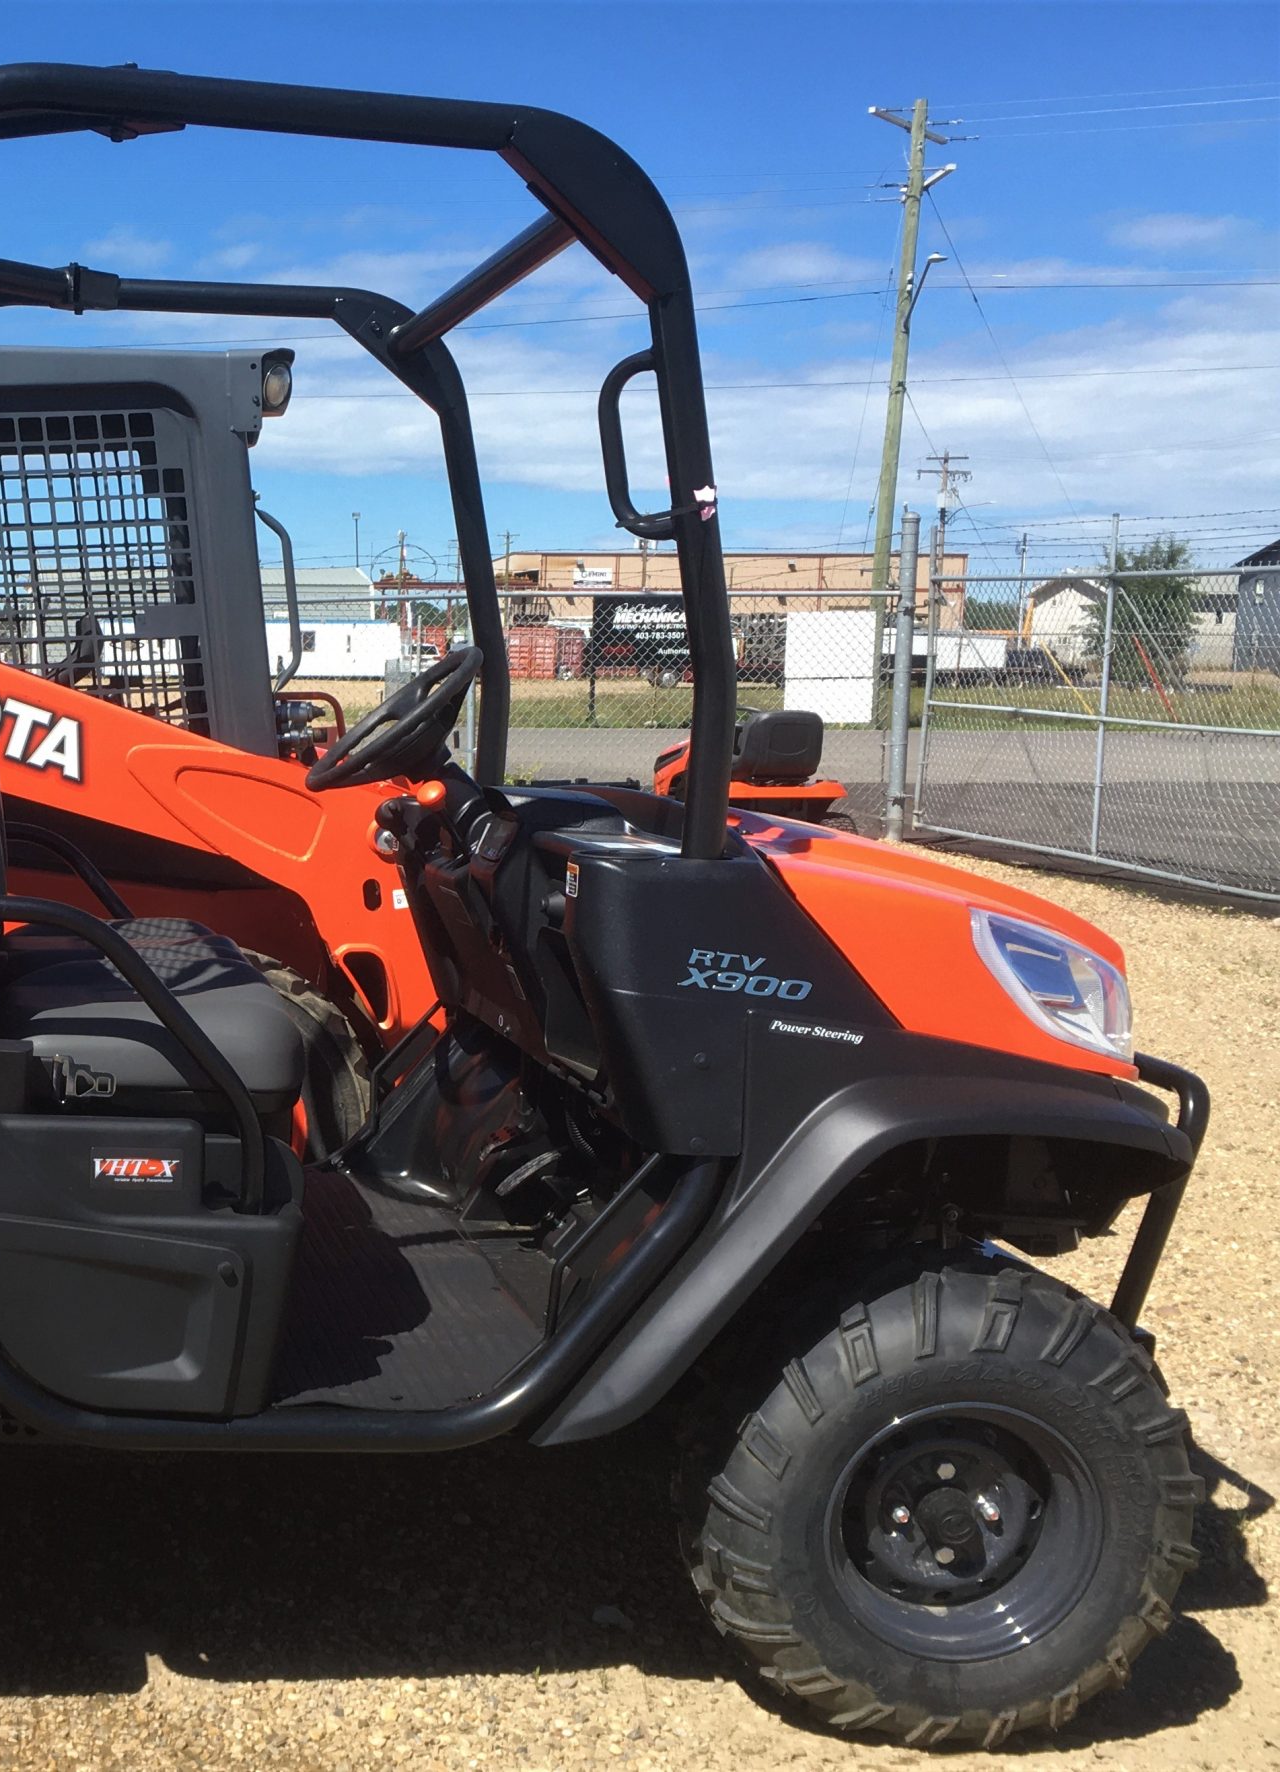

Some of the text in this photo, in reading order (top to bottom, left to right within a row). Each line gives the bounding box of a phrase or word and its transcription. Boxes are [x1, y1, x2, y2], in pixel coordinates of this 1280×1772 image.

[613, 611, 688, 623] MECHANICA
[634, 631, 685, 640] 403-783-3501
[657, 647, 690, 656] Authorize
[688, 949, 767, 972] RTV
[677, 967, 813, 1000] X900
[771, 1020, 864, 1045] Power Steering
[93, 1158, 180, 1179] VHT-X
